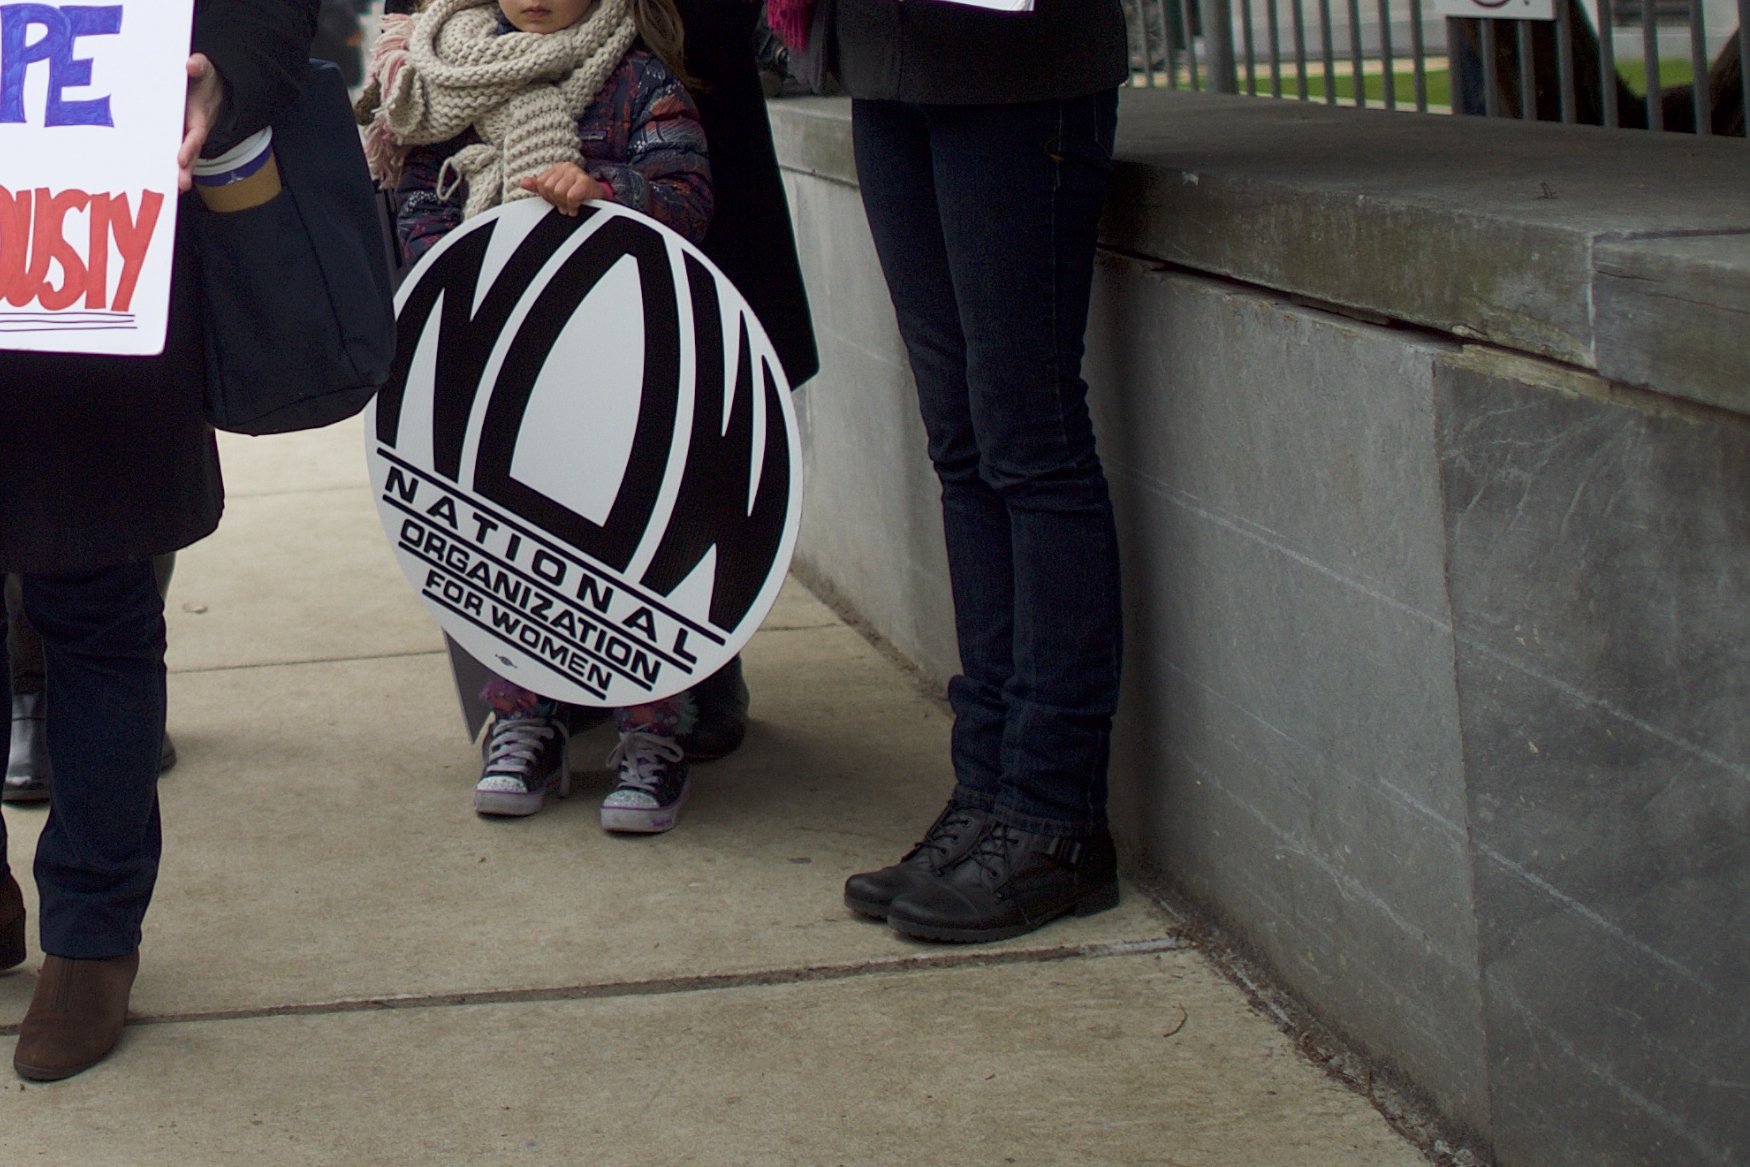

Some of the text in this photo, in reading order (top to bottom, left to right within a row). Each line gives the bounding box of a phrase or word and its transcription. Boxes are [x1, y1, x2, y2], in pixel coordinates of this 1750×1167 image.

[376, 206, 791, 634] NOW
[384, 465, 698, 664] NATIONAL
[399, 518, 662, 685] ORGANIZATION
[425, 568, 613, 692] FOR WOMEN
